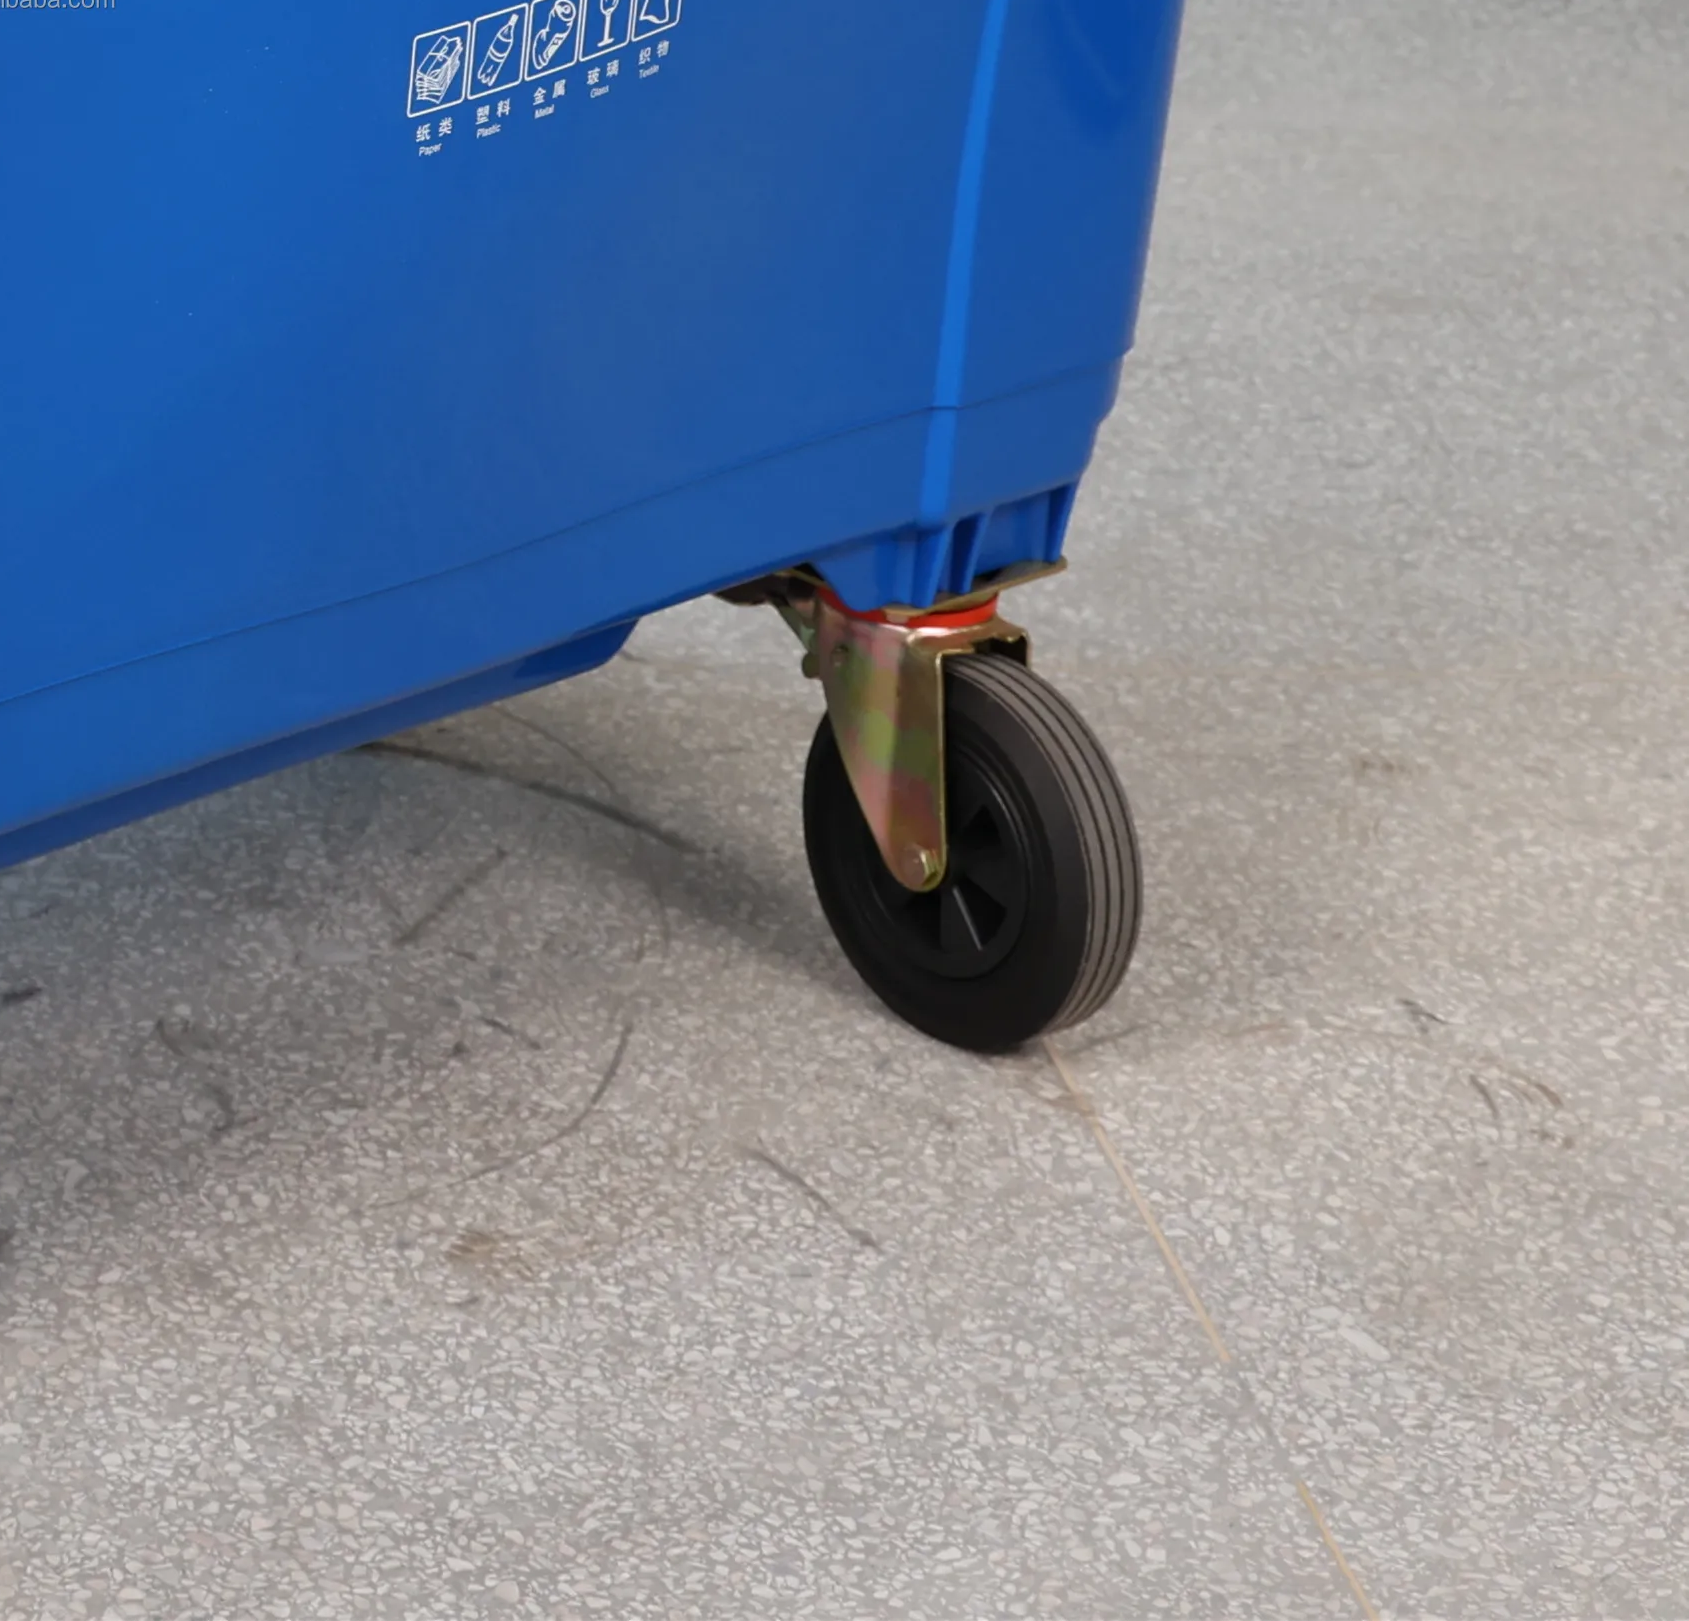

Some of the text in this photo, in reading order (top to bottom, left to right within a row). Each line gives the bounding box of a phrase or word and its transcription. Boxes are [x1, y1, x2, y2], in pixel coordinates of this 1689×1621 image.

[475, 97, 511, 125] 塑料
[415, 116, 453, 143] 纸类
[476, 122, 502, 139] Plastic
[418, 142, 443, 157] Paper
